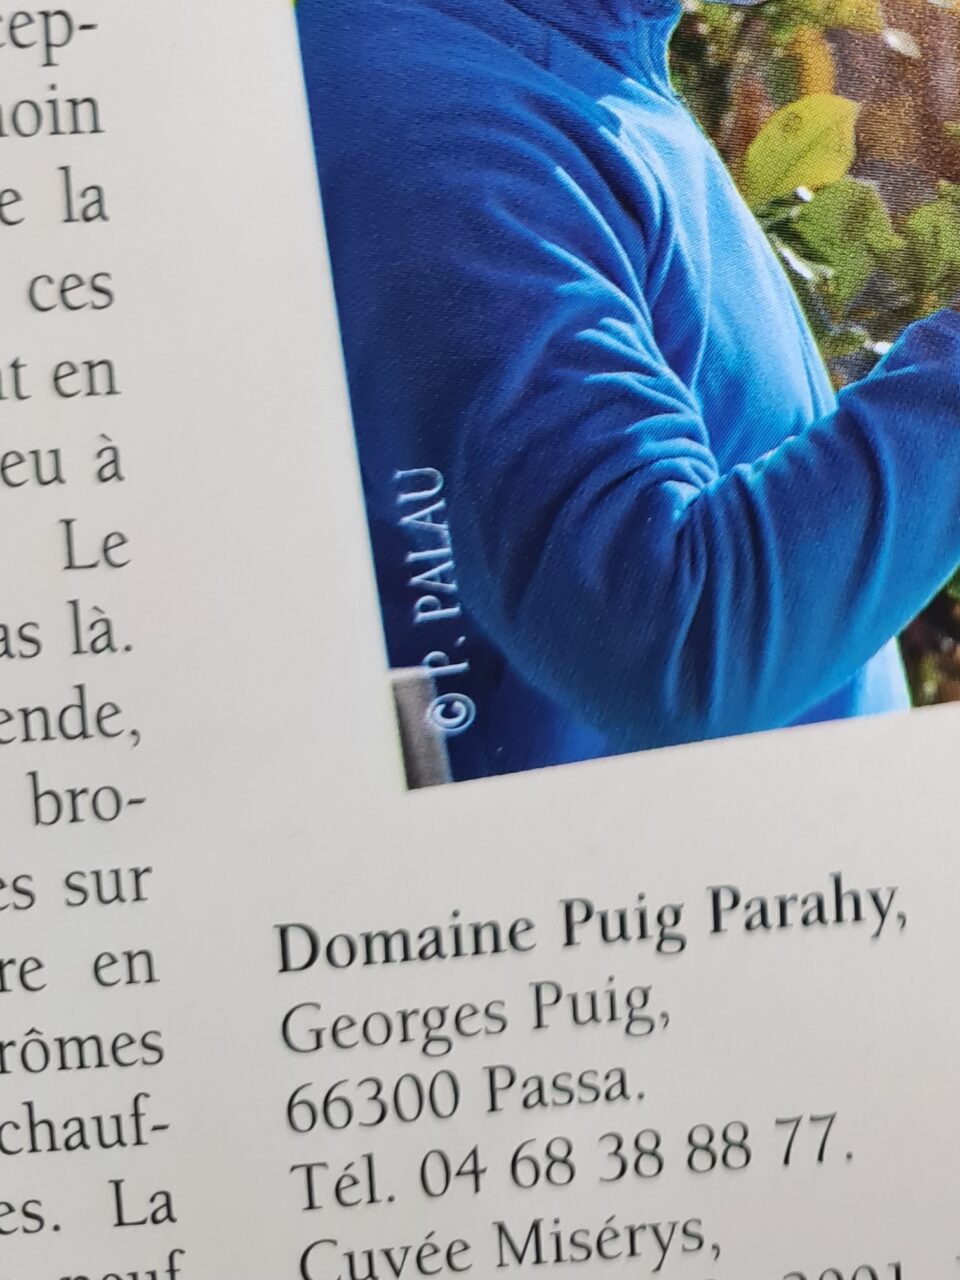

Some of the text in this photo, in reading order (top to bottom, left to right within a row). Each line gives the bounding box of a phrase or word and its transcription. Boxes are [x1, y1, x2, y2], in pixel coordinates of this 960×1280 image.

[57, 165, 110, 224] la
[27, 271, 115, 313] ces
[52, 358, 122, 399] en
[0, 433, 125, 489] eu à
[58, 518, 131, 571] Le
[392, 467, 462, 623] PALAU
[66, 598, 133, 656] là.
[422, 635, 470, 679] P.
[0, 683, 141, 748] ende,
[26, 770, 147, 827] bro-
[63, 866, 153, 908] sur
[273, 871, 907, 974] Domaine Puig Parahy,
[0, 949, 161, 994] re en
[280, 975, 670, 1058] Georges Puig,
[0, 1026, 165, 1075] rômes
[0, 1091, 170, 1156] chauf-
[285, 1064, 645, 1134] 66300 Passa.
[289, 1112, 853, 1211] Tél. 04 68 38 88 77.
[0, 1178, 178, 1236] es. La
[299, 1214, 721, 1280] Cuvée Misérys,
